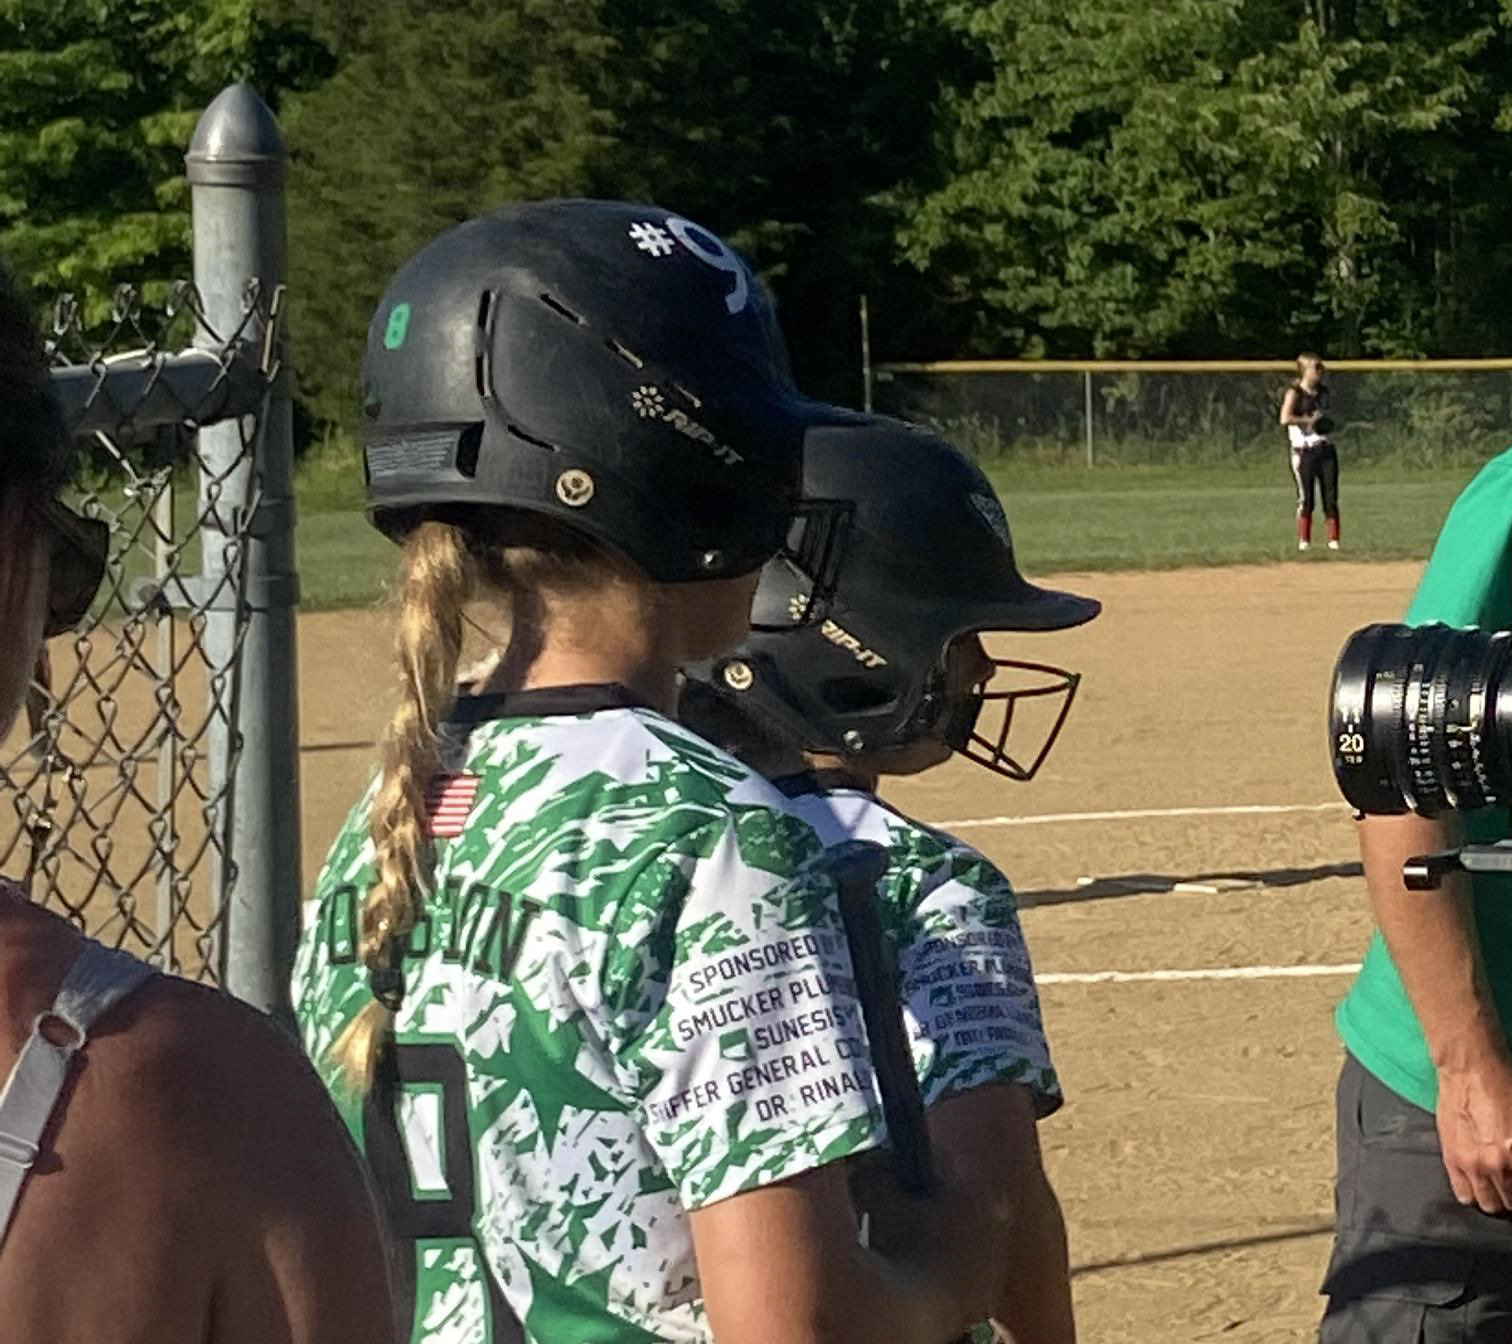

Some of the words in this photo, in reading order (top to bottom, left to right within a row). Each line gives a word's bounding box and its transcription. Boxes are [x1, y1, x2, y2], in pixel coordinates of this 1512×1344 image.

[1339, 733, 1365, 753] 20
[689, 934, 820, 994] SPONSORED
[678, 988, 786, 1042] SMUCKER
[727, 1045, 832, 1096] GENERAL
